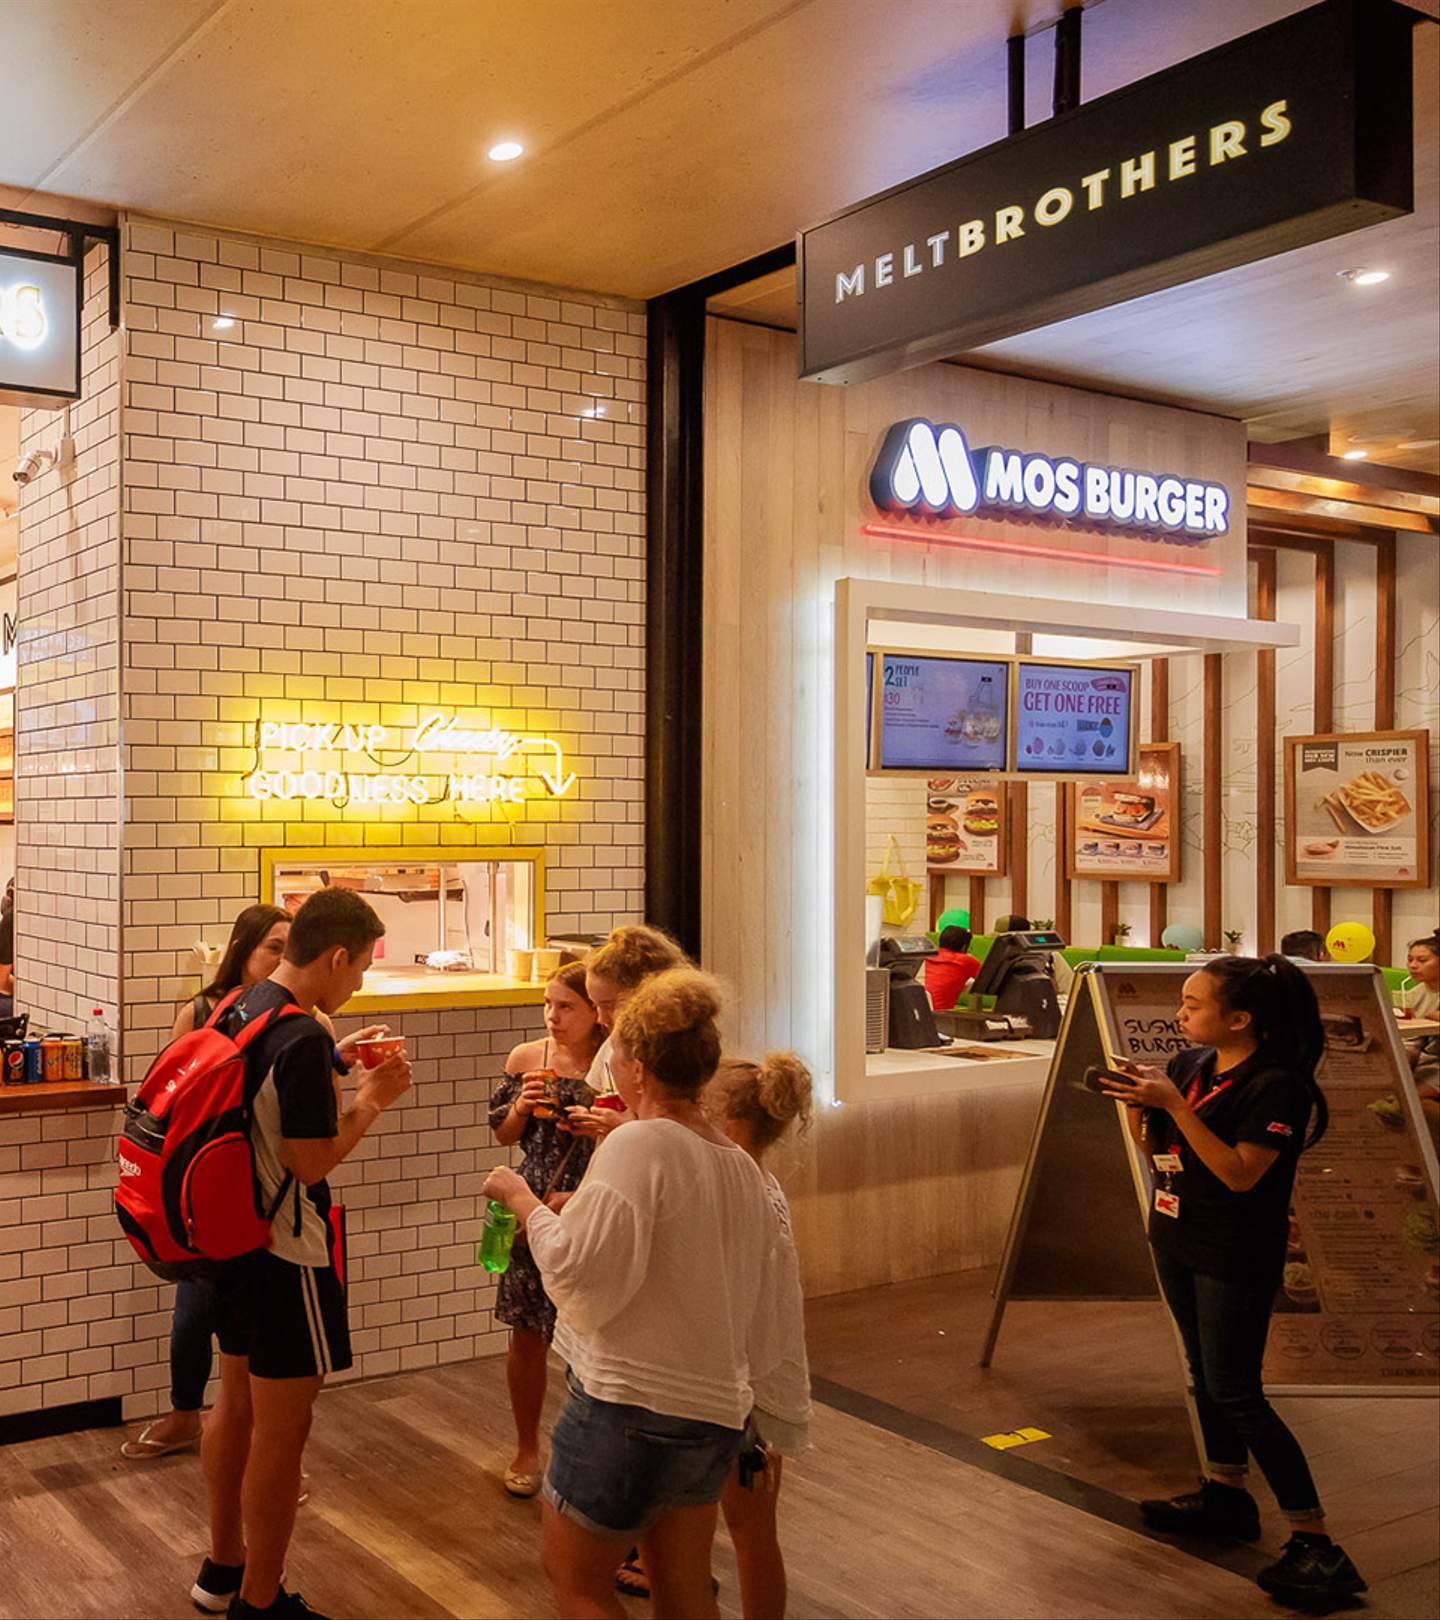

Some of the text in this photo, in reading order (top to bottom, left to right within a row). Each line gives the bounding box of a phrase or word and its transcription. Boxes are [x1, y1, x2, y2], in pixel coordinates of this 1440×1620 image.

[985, 450, 1083, 512] MOS
[1084, 460, 1228, 533] BURGER
[1025, 678, 1090, 692] BUY ONE SCOOP
[1024, 691, 1121, 715] GET ONE FREE
[259, 721, 335, 752] PICK
[342, 724, 387, 753] UP
[1365, 748, 1408, 757] CRISPIER
[248, 770, 526, 804] GOODNESS HERE
